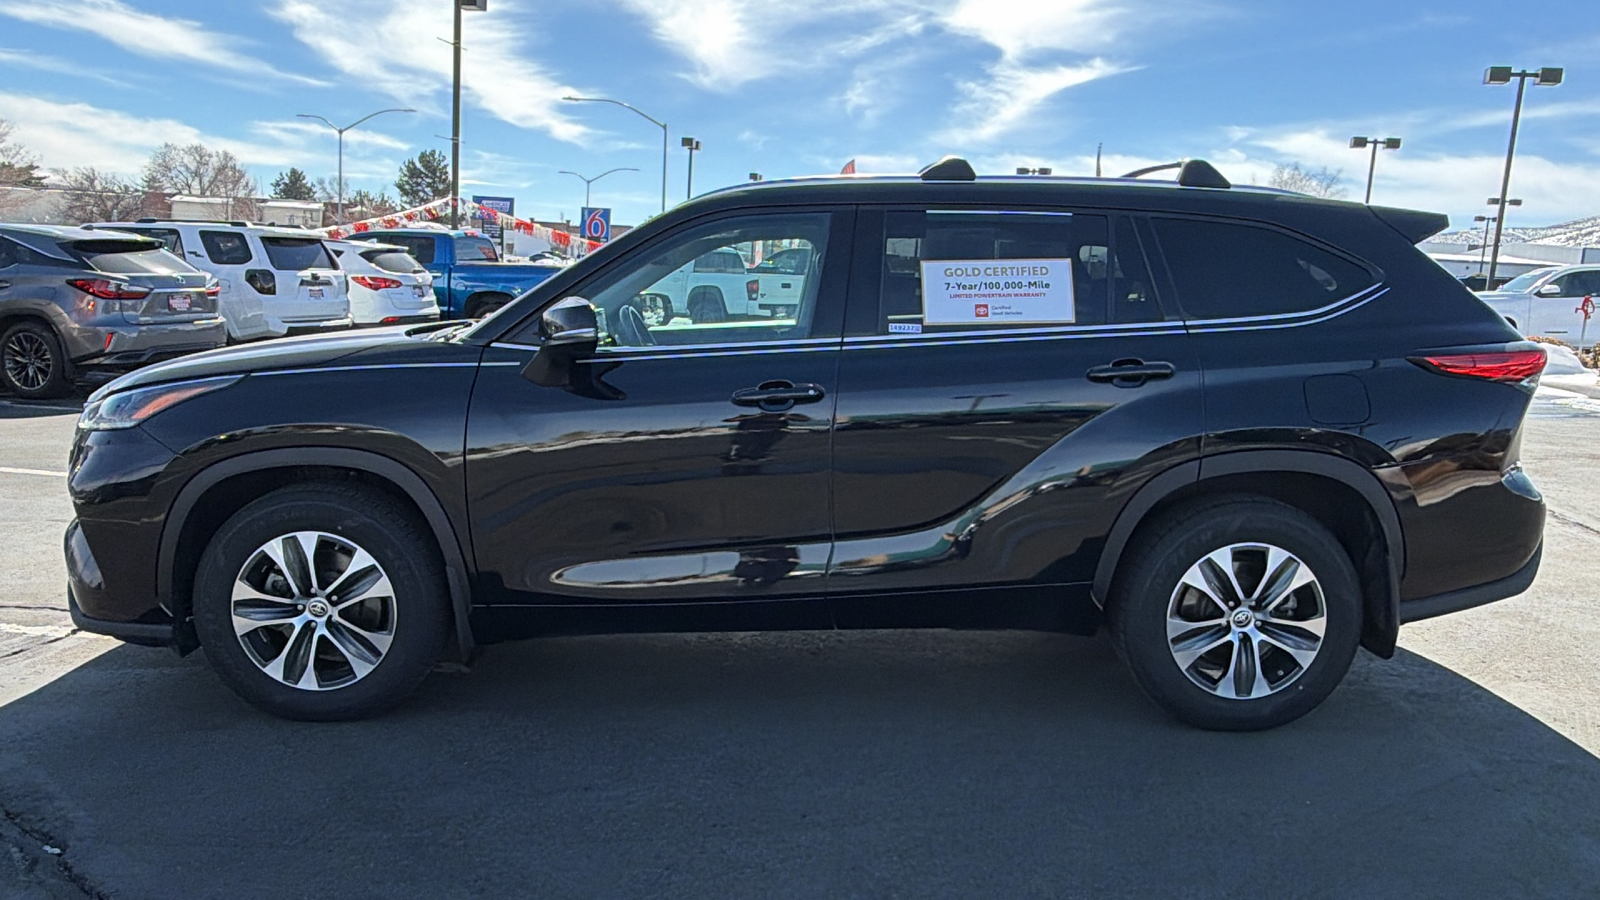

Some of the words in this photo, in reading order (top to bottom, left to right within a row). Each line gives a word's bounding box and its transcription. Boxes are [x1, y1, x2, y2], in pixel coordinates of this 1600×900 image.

[586, 208, 606, 237] 6
[944, 268, 980, 277] GOLD
[984, 266, 1048, 276] CERTIFIED
[944, 280, 1050, 291] 7-Year/100,000-Mile
